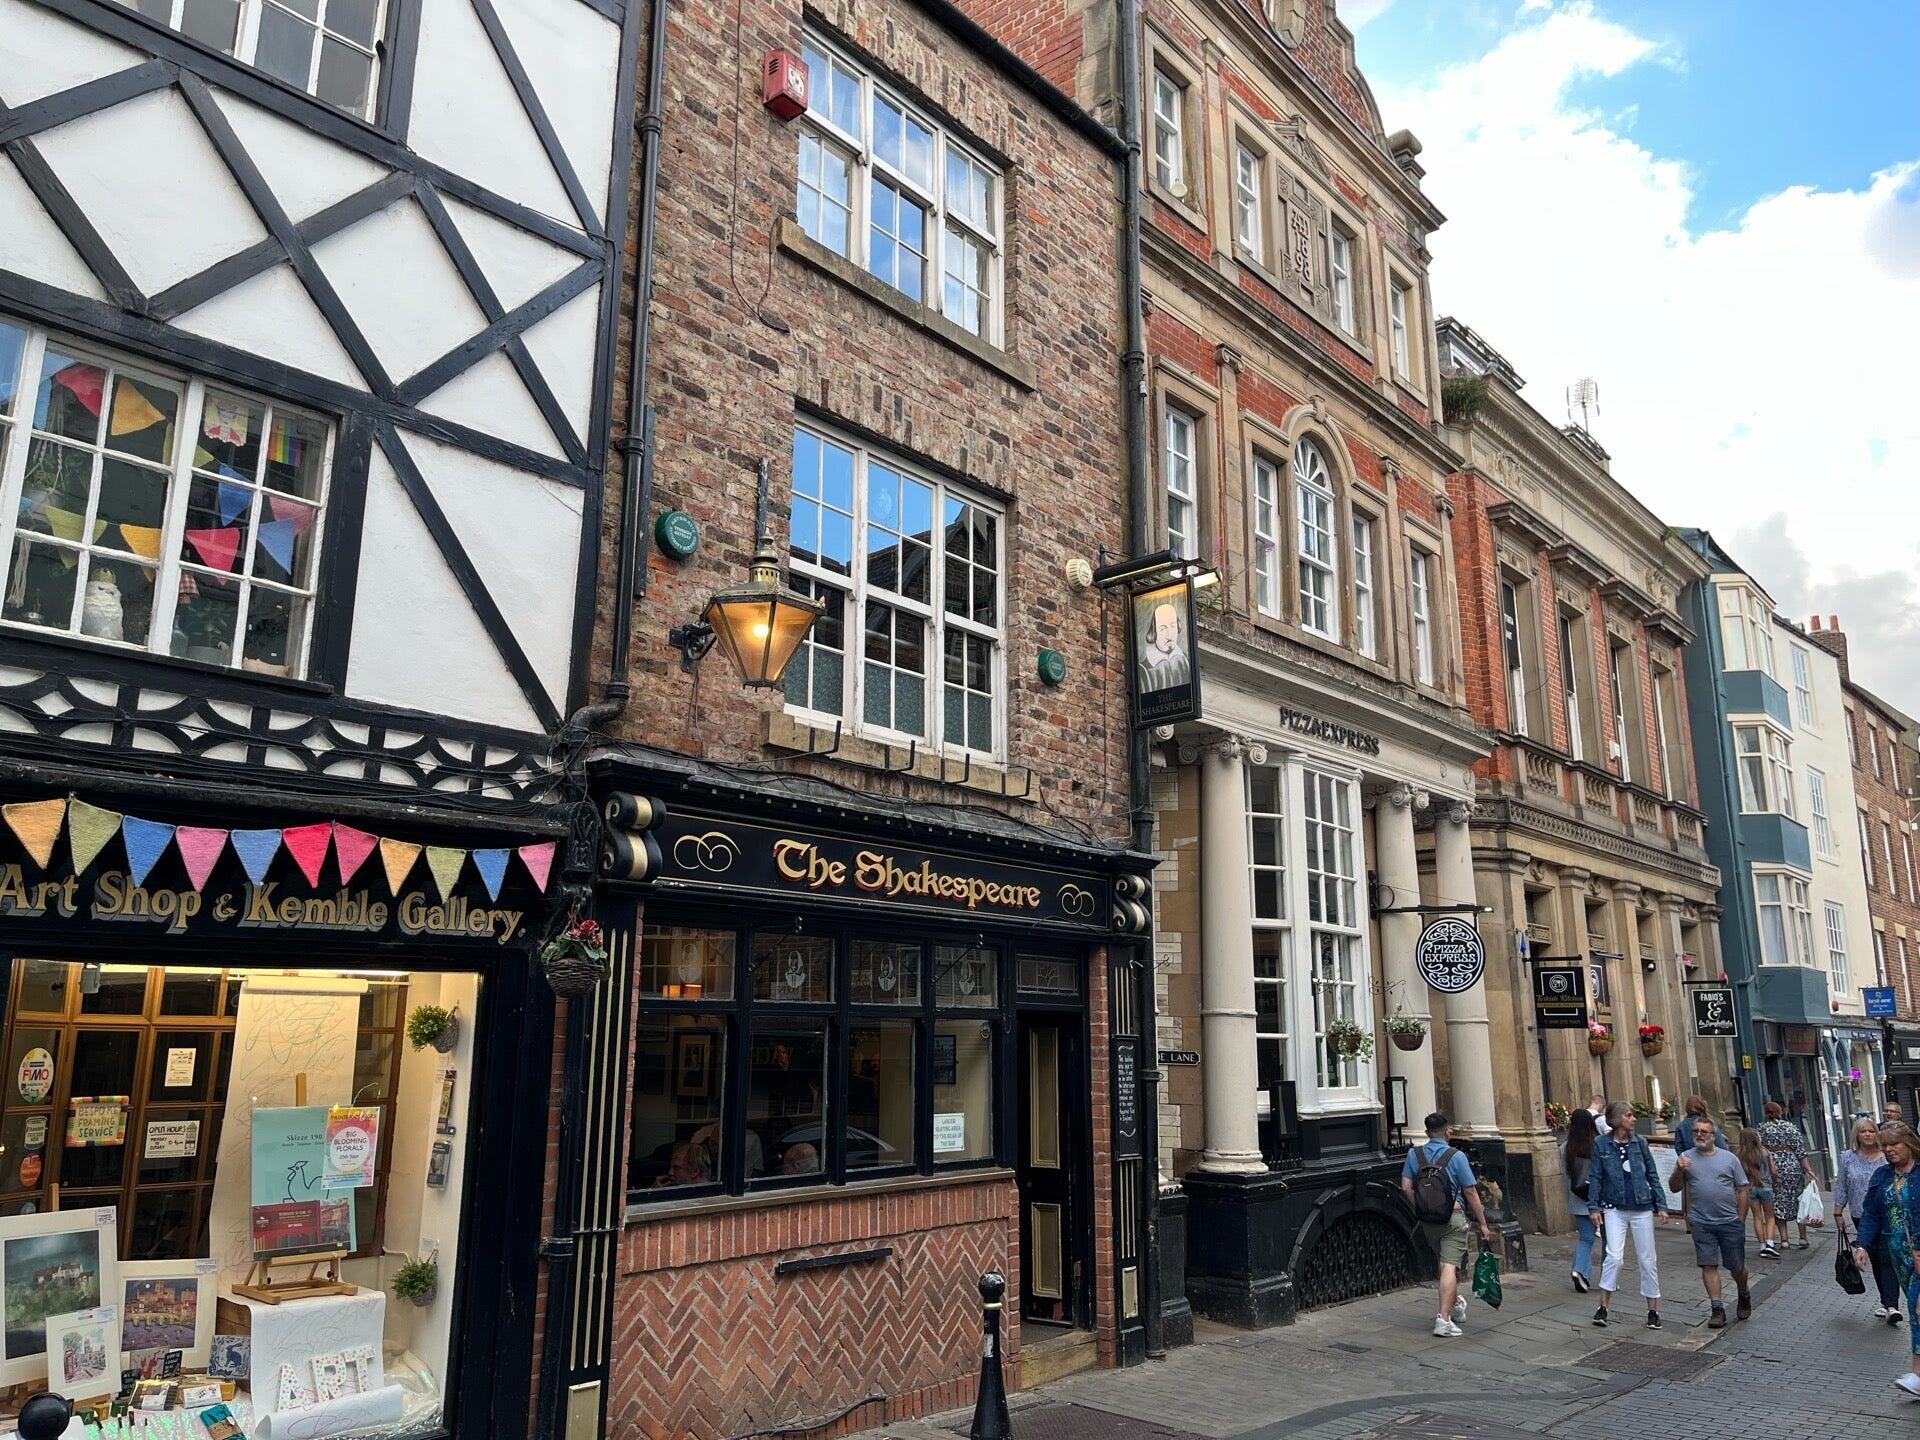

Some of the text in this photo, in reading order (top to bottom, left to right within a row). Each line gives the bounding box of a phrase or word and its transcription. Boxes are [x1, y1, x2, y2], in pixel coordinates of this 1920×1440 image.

[1158, 693, 1173, 702] THE
[1142, 700, 1190, 716] SHAKESPEARE
[1279, 706, 1380, 757] PIZZAEXPRESS
[773, 839, 1041, 911] The Shakespeare
[0, 863, 79, 917] Art
[91, 870, 202, 934] Shop
[212, 893, 239, 922] &
[237, 881, 388, 932] Kemble
[1433, 944, 1467, 954] PIZZA
[1424, 953, 1477, 963] EXPRESS
[1700, 992, 1724, 1001] FABIO'S
[1707, 1001, 1722, 1021] &
[1170, 1053, 1196, 1062] LANE
[1743, 1056, 1751, 1067] H
[22, 1068, 49, 1081] FIMO
[78, 1104, 118, 1116] BESPOKE
[78, 1117, 116, 1128] FRAMING
[78, 1126, 114, 1138] SERVICE
[149, 1126, 166, 1134] OPEN
[333, 1137, 367, 1145] BLOOMING
[276, 1345, 376, 1412] ART
